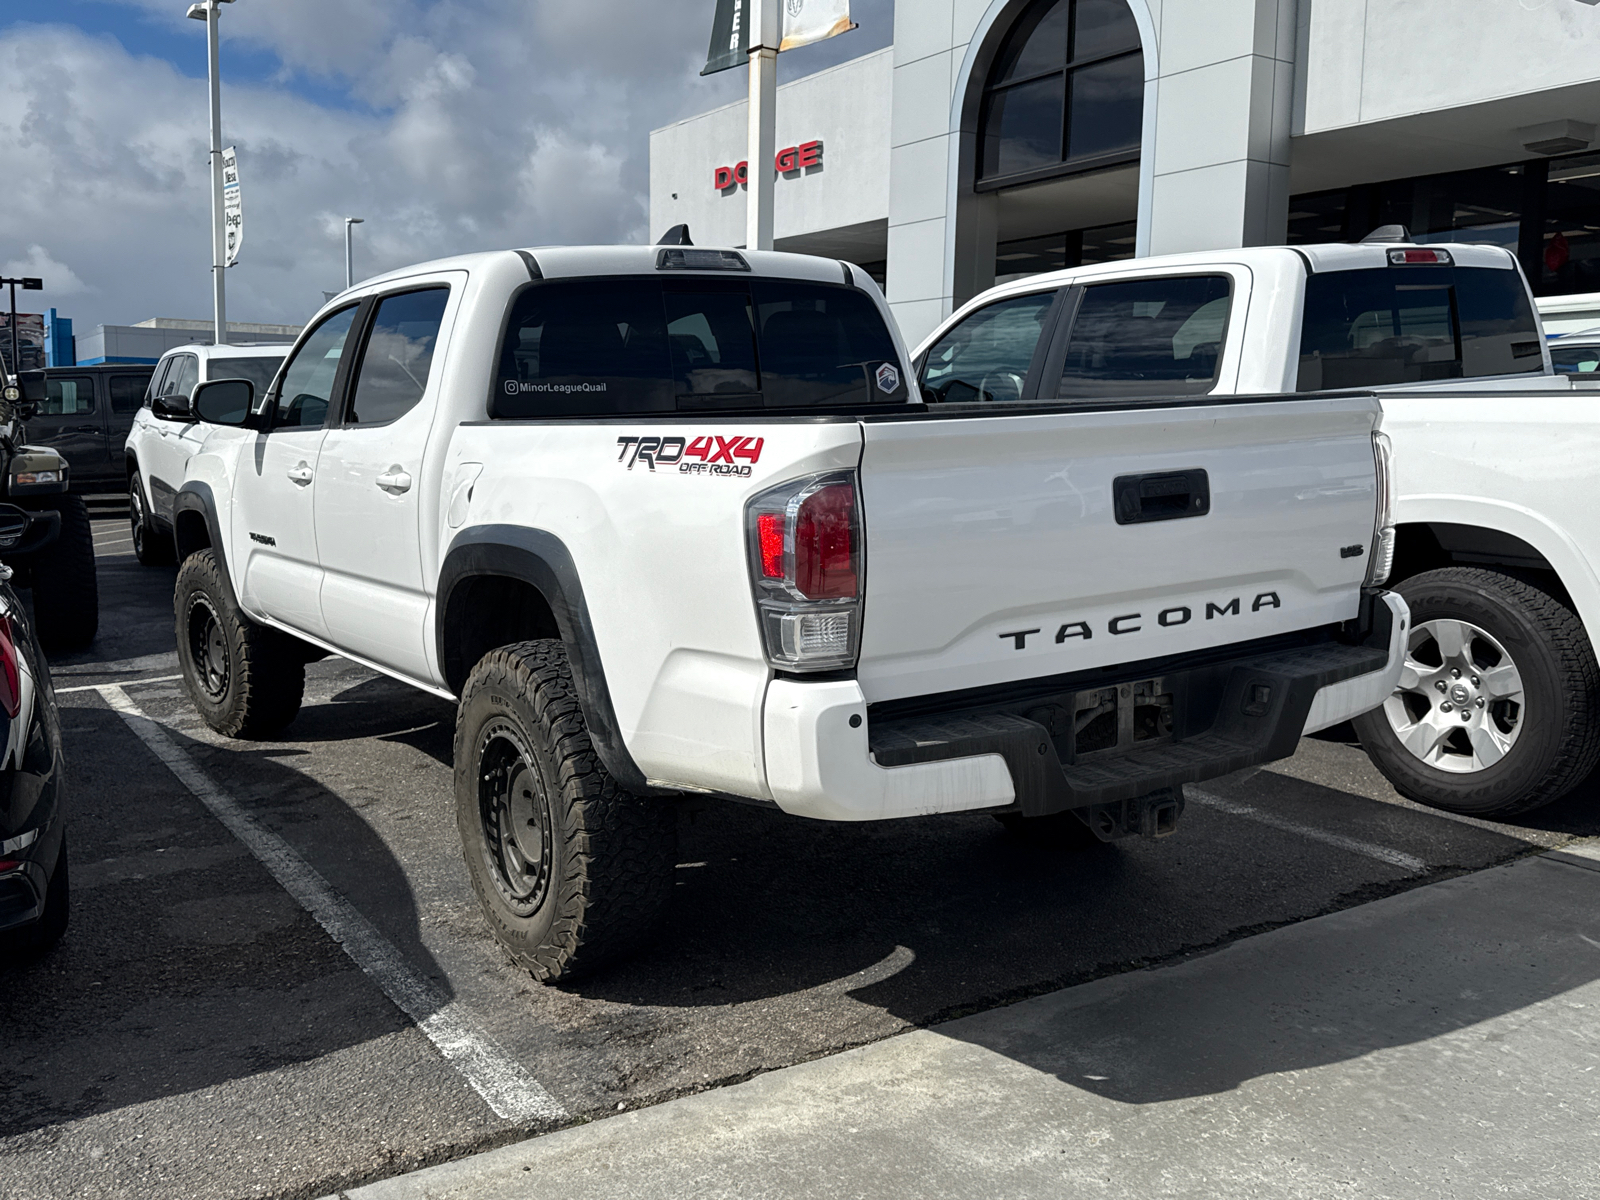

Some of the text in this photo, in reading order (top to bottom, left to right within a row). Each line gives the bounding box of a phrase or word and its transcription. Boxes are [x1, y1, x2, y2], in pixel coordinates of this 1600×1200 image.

[715, 140, 823, 192] DOGE
[519, 382, 607, 394] MinorLeagueQuail
[617, 436, 686, 472] TRD
[679, 462, 752, 478] OFF ROAD
[1146, 480, 1189, 496] TOYOTA
[999, 591, 1281, 650] TACOMA
